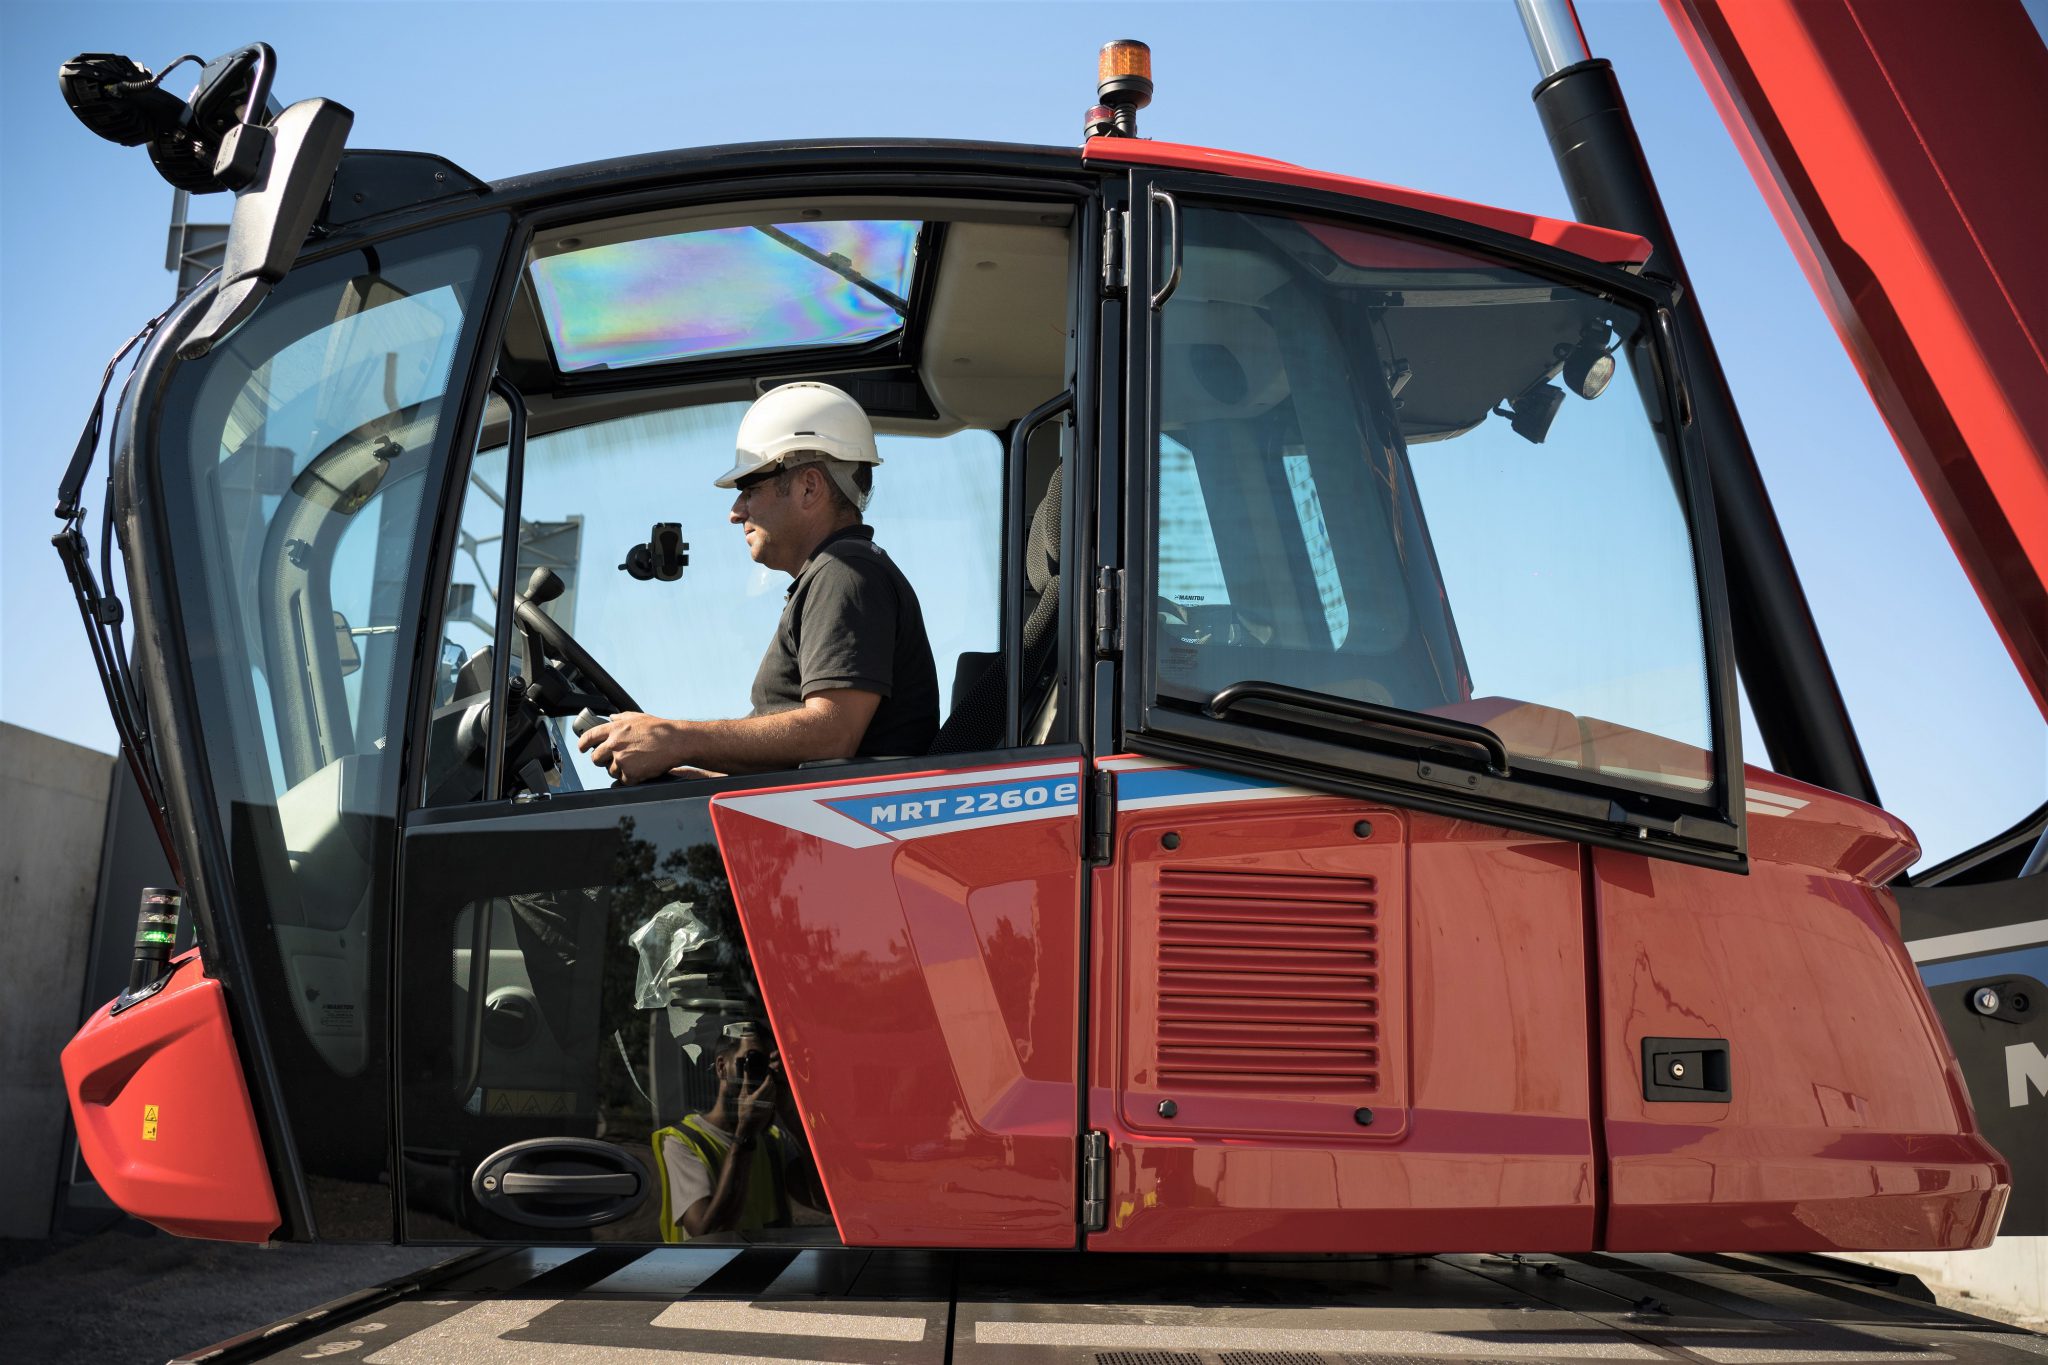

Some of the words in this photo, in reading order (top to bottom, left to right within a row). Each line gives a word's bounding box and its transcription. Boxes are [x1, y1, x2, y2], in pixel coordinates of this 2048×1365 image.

[870, 798, 947, 825] MRT
[954, 787, 1048, 815] 2260
[1054, 783, 1077, 802] e
